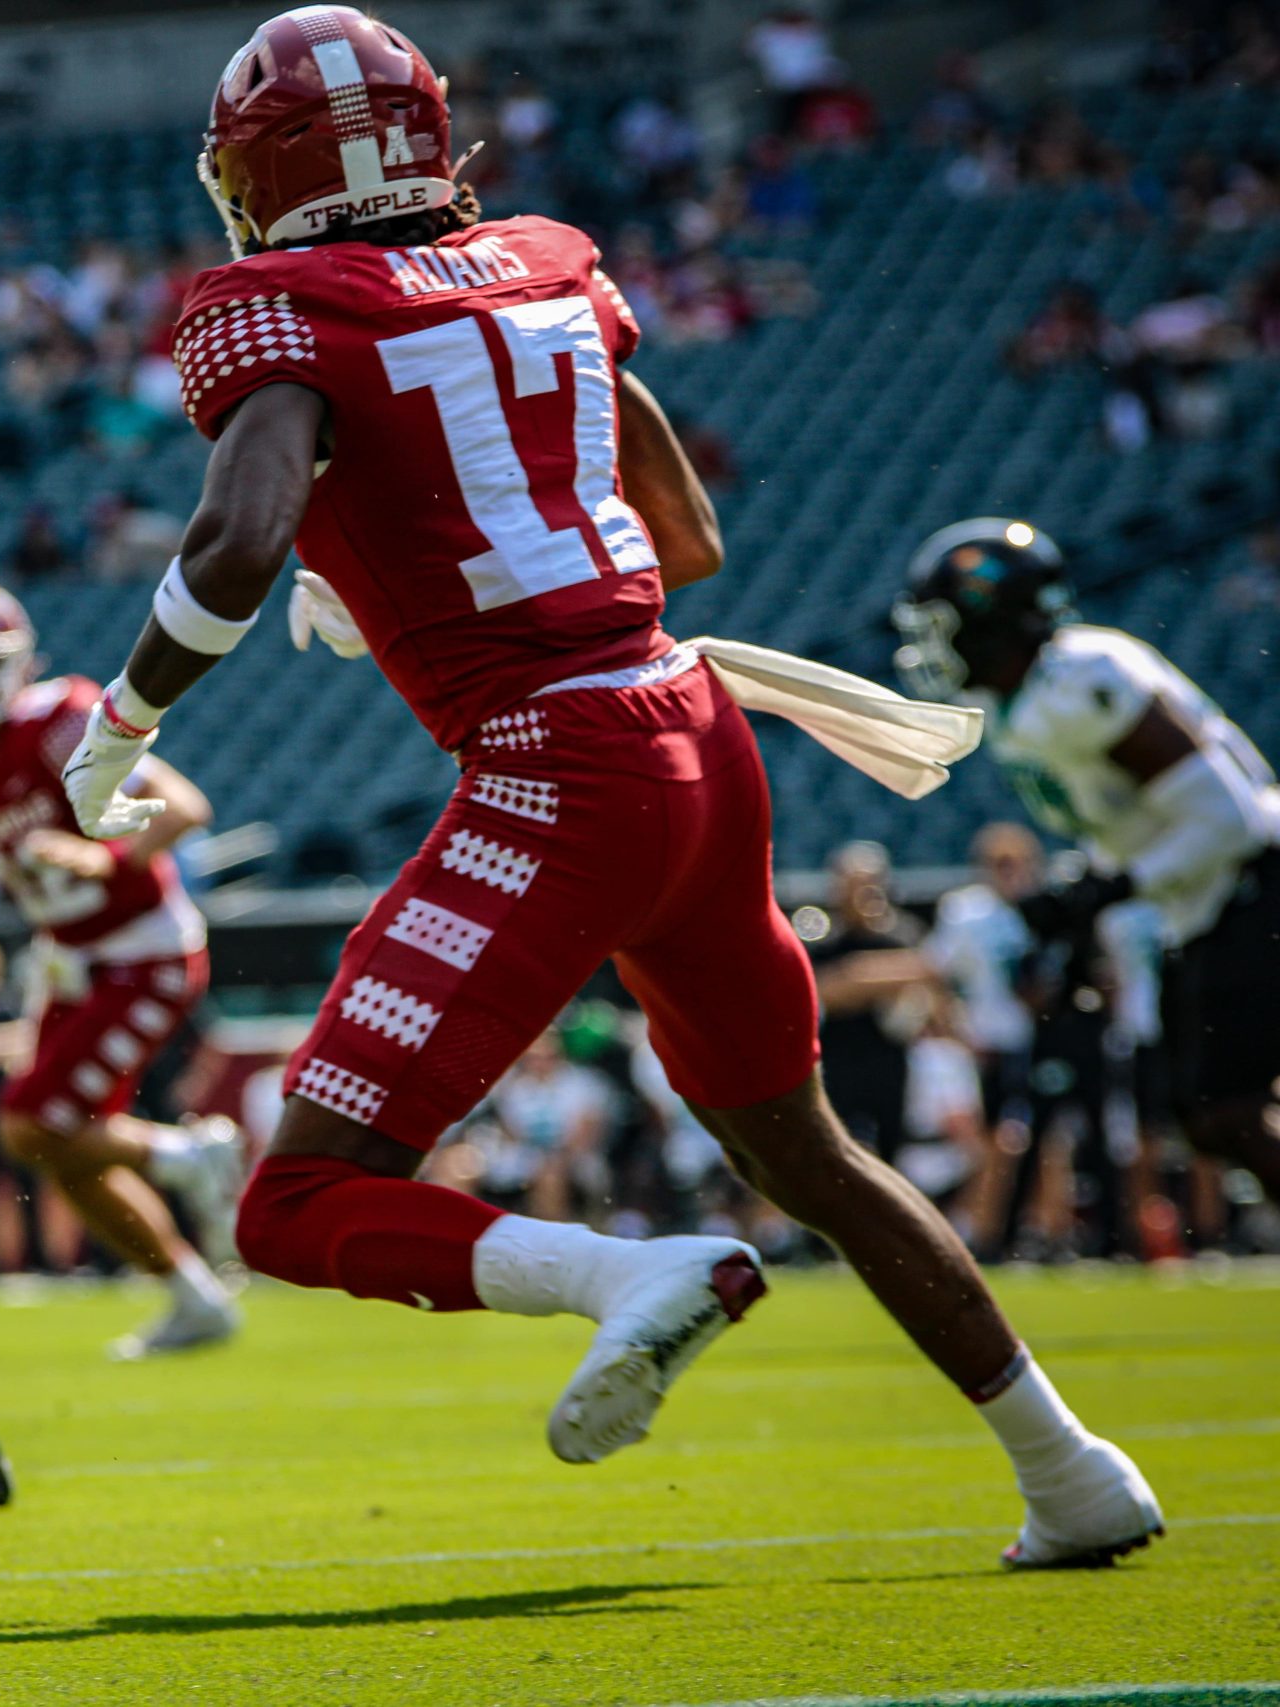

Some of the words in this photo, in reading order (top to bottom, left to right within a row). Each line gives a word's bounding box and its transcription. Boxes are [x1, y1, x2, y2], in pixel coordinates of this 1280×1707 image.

[303, 187, 428, 229] TEMPLE
[382, 235, 530, 297] ADAMS
[374, 295, 661, 613] 17
